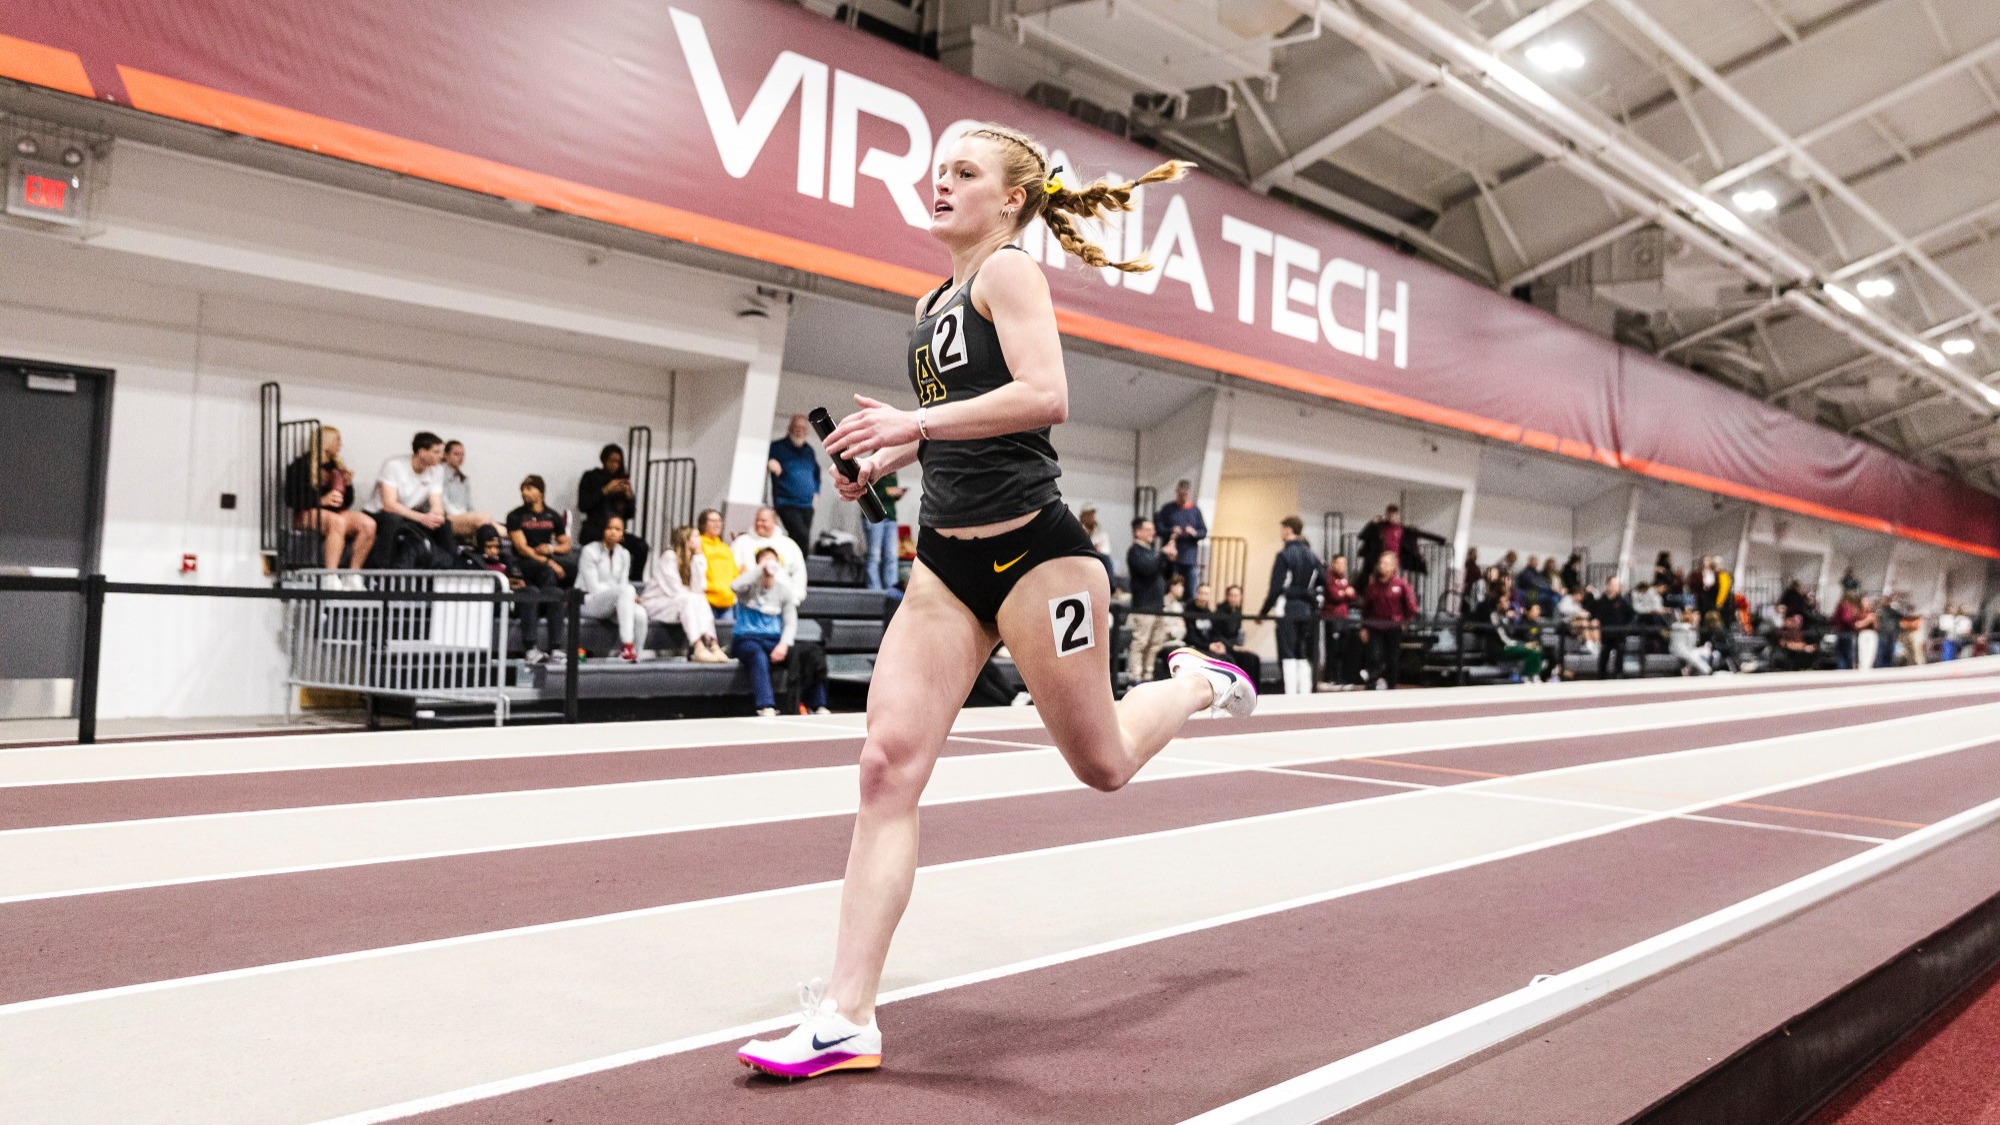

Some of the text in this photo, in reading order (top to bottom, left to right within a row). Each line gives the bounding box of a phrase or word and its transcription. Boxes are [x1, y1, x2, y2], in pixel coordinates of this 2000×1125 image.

[25, 175, 67, 210] EXIT
[668, 5, 1409, 370] VIRNIA TECH
[936, 313, 962, 368] 2
[915, 344, 947, 406] A
[1055, 598, 1086, 653] 2
